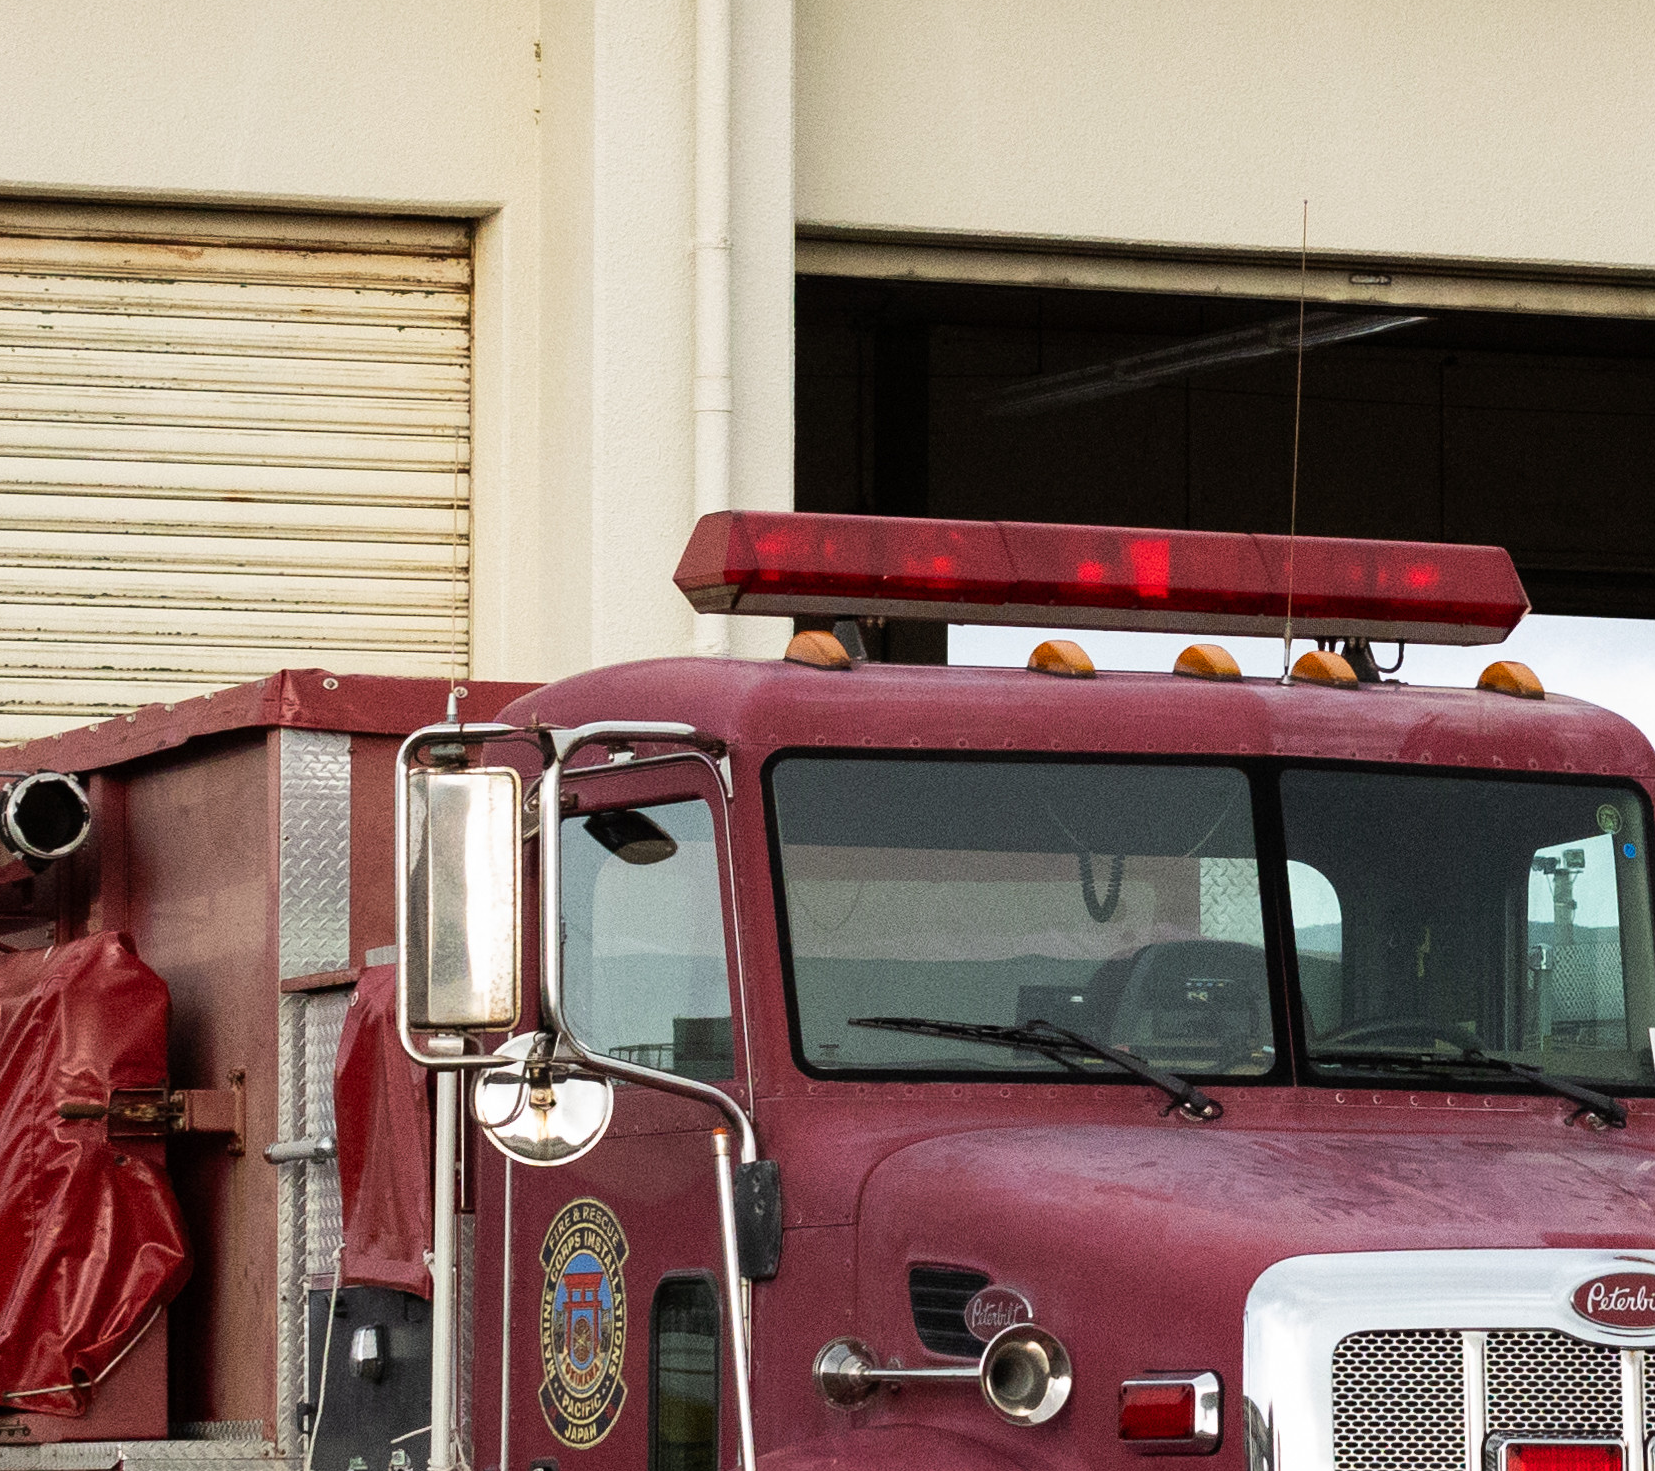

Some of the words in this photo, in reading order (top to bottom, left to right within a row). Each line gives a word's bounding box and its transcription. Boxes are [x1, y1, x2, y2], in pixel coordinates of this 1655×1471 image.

[549, 1212, 571, 1250] FIRE
[583, 1206, 620, 1247] RESCUE
[550, 1231, 581, 1283] CORPS
[561, 1393, 602, 1418] PACIFIC
[564, 1422, 597, 1441] JAPAN
